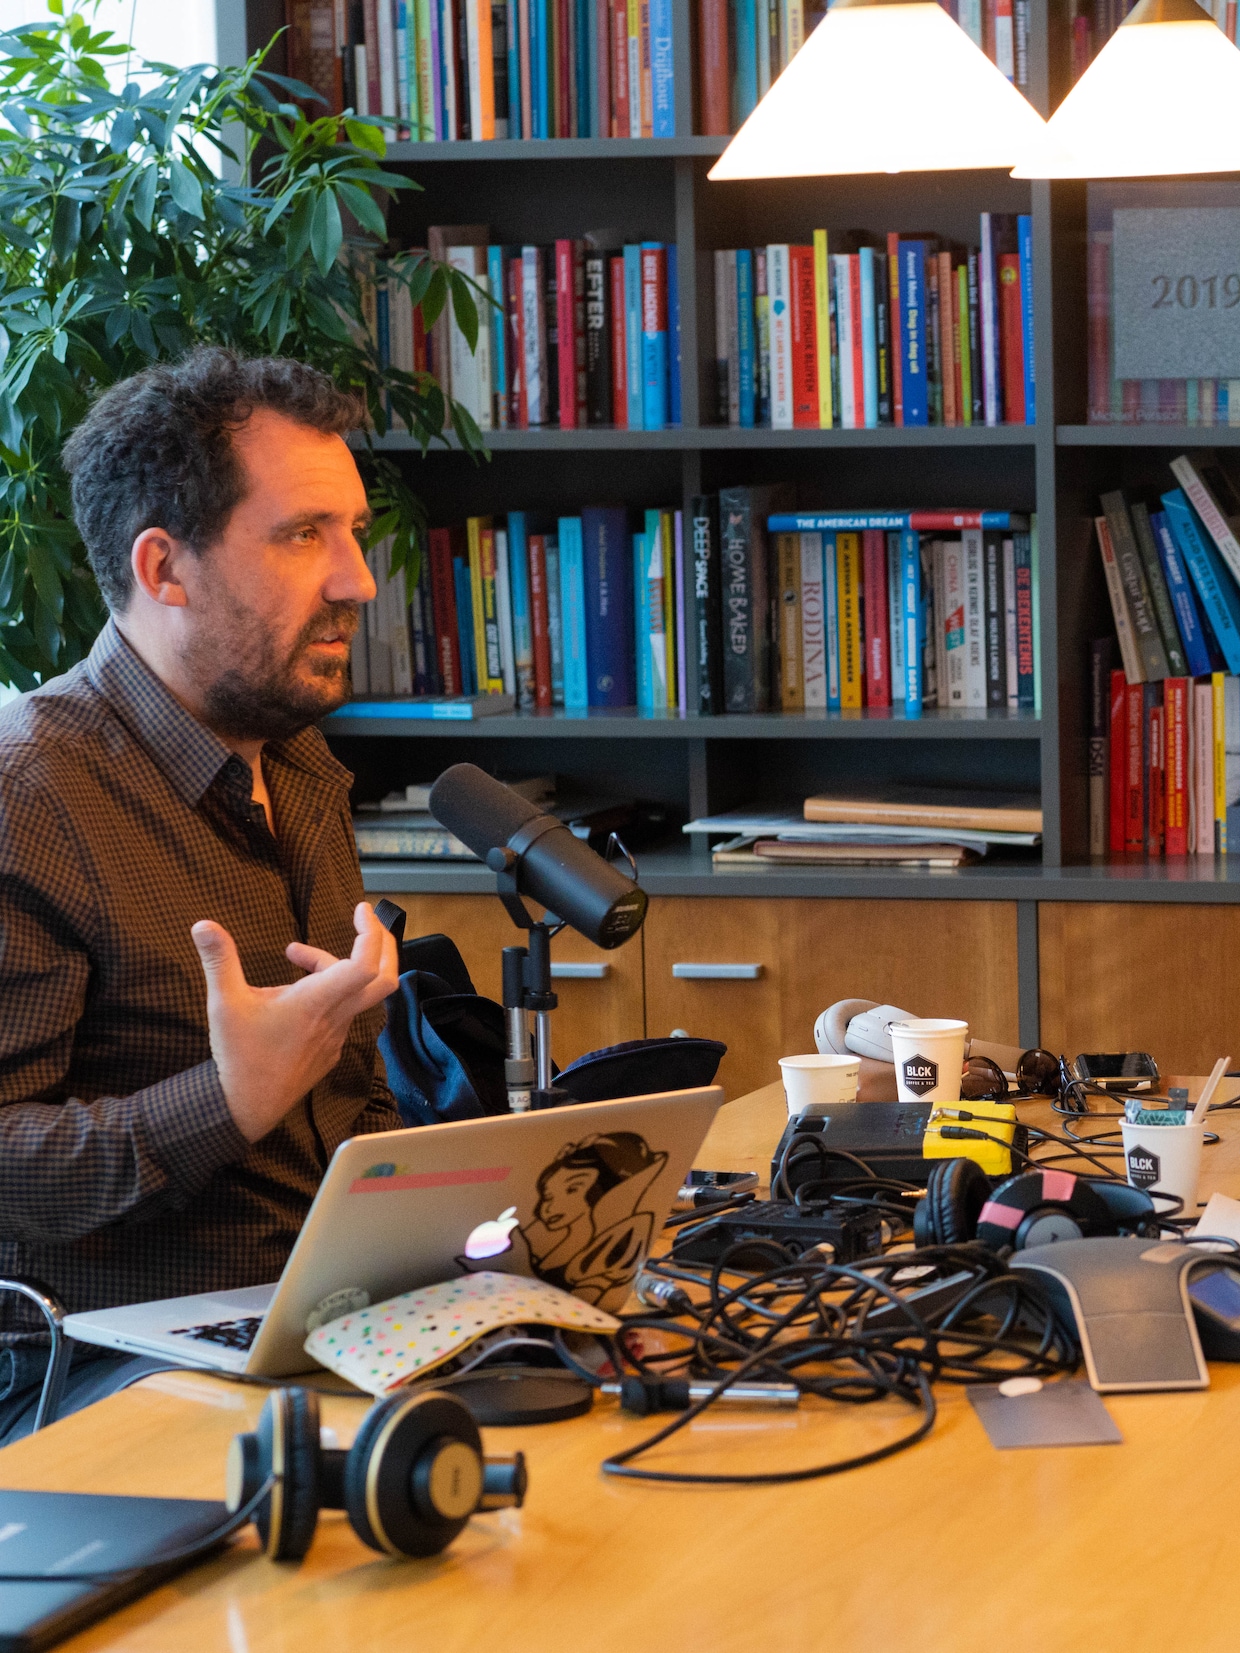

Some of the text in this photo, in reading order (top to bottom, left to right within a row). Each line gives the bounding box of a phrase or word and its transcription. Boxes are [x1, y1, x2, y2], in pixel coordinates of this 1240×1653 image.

[907, 251, 916, 279] Annet
[588, 259, 604, 330] EFTER
[907, 280, 918, 307] Mooij
[907, 309, 918, 329] Dag
[907, 341, 919, 359] dag
[909, 361, 919, 374] uit
[796, 516, 904, 529] THE AMERICAN DREAM
[693, 516, 711, 599] DEEP SPACE
[728, 538, 748, 654] HOME BAKED
[1017, 567, 1032, 675] DE BEKENTENIS
[1210, 593, 1234, 631] VINDEN
[802, 581, 823, 683] RODINA
[906, 1065, 932, 1077] BLCK
[1130, 1157, 1154, 1170] BLCK
